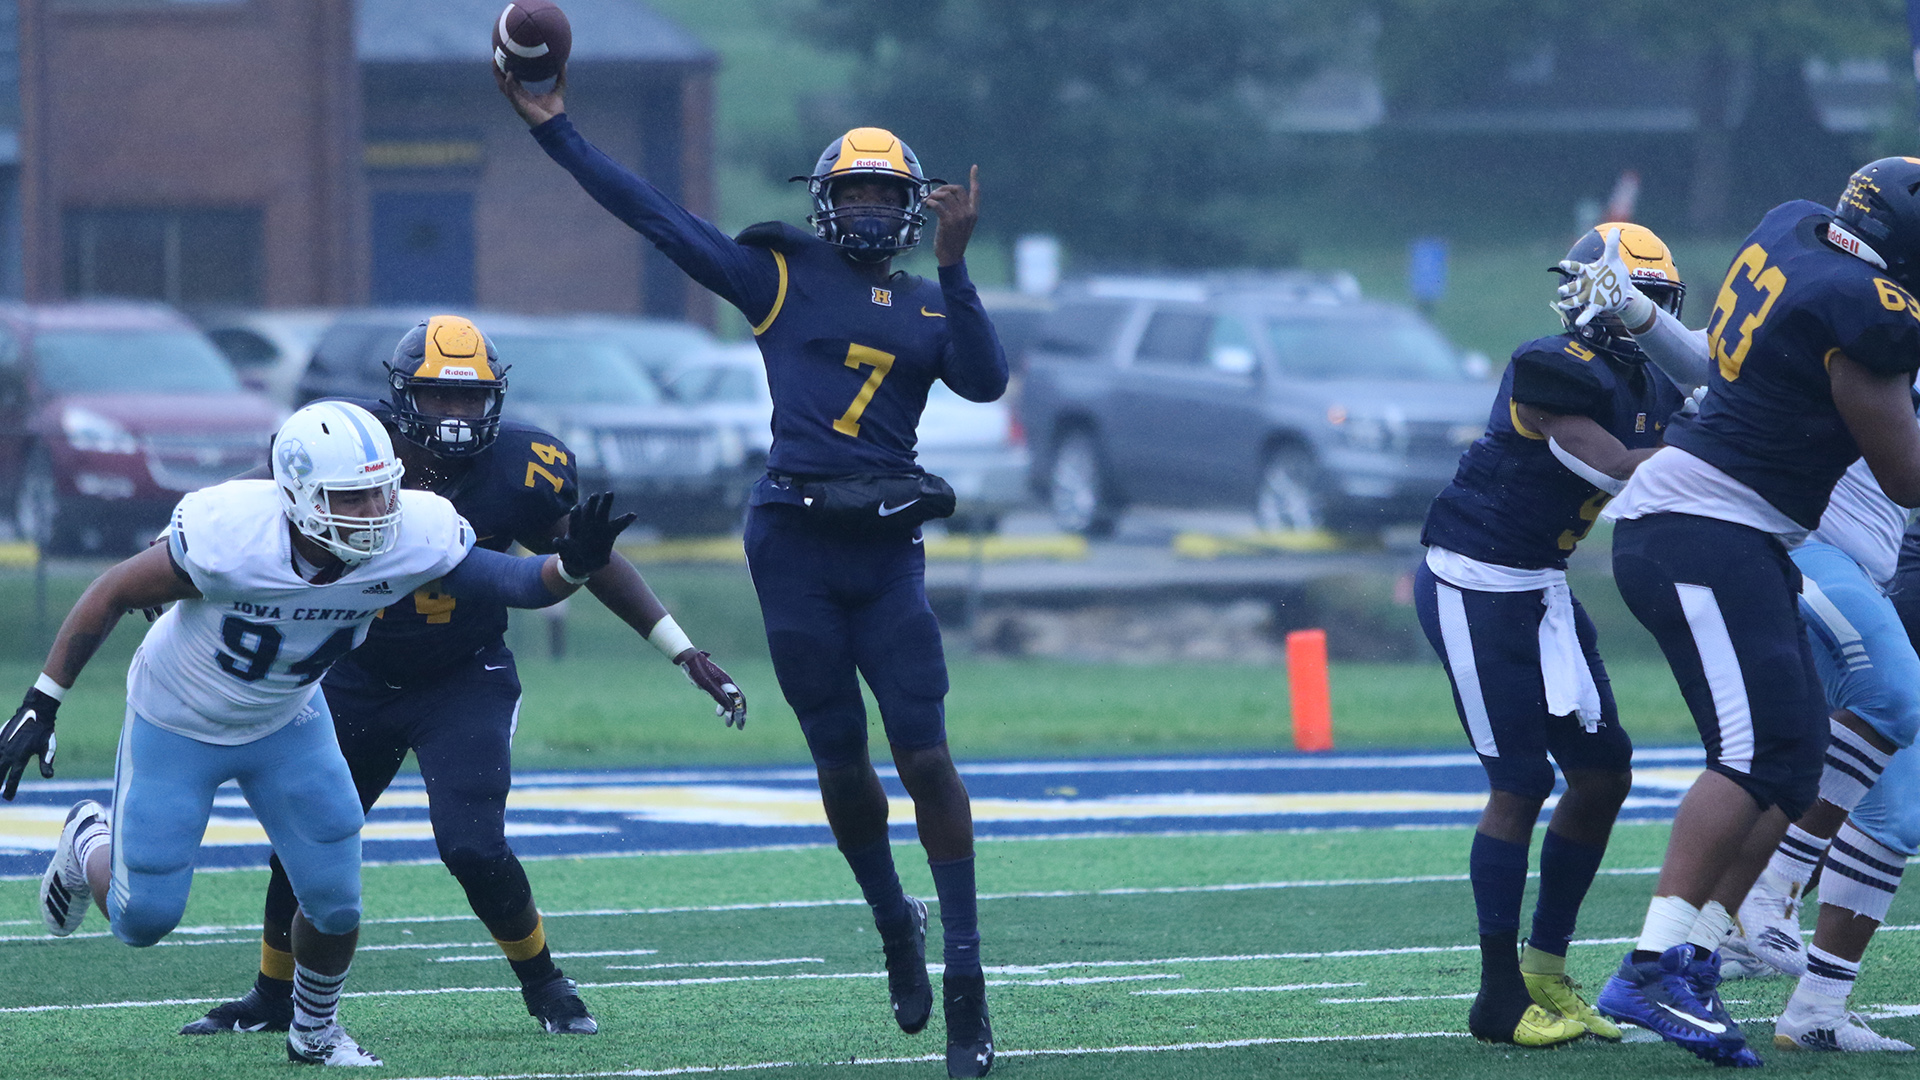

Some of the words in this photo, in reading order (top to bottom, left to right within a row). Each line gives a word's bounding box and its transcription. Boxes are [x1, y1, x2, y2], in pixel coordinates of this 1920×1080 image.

[871, 286, 892, 307] H
[1707, 243, 1787, 382] 63
[444, 368, 474, 377] Riddell
[832, 342, 896, 438] 7
[364, 461, 386, 473] Riddell
[524, 441, 568, 494] 74
[231, 601, 282, 620] IOWA
